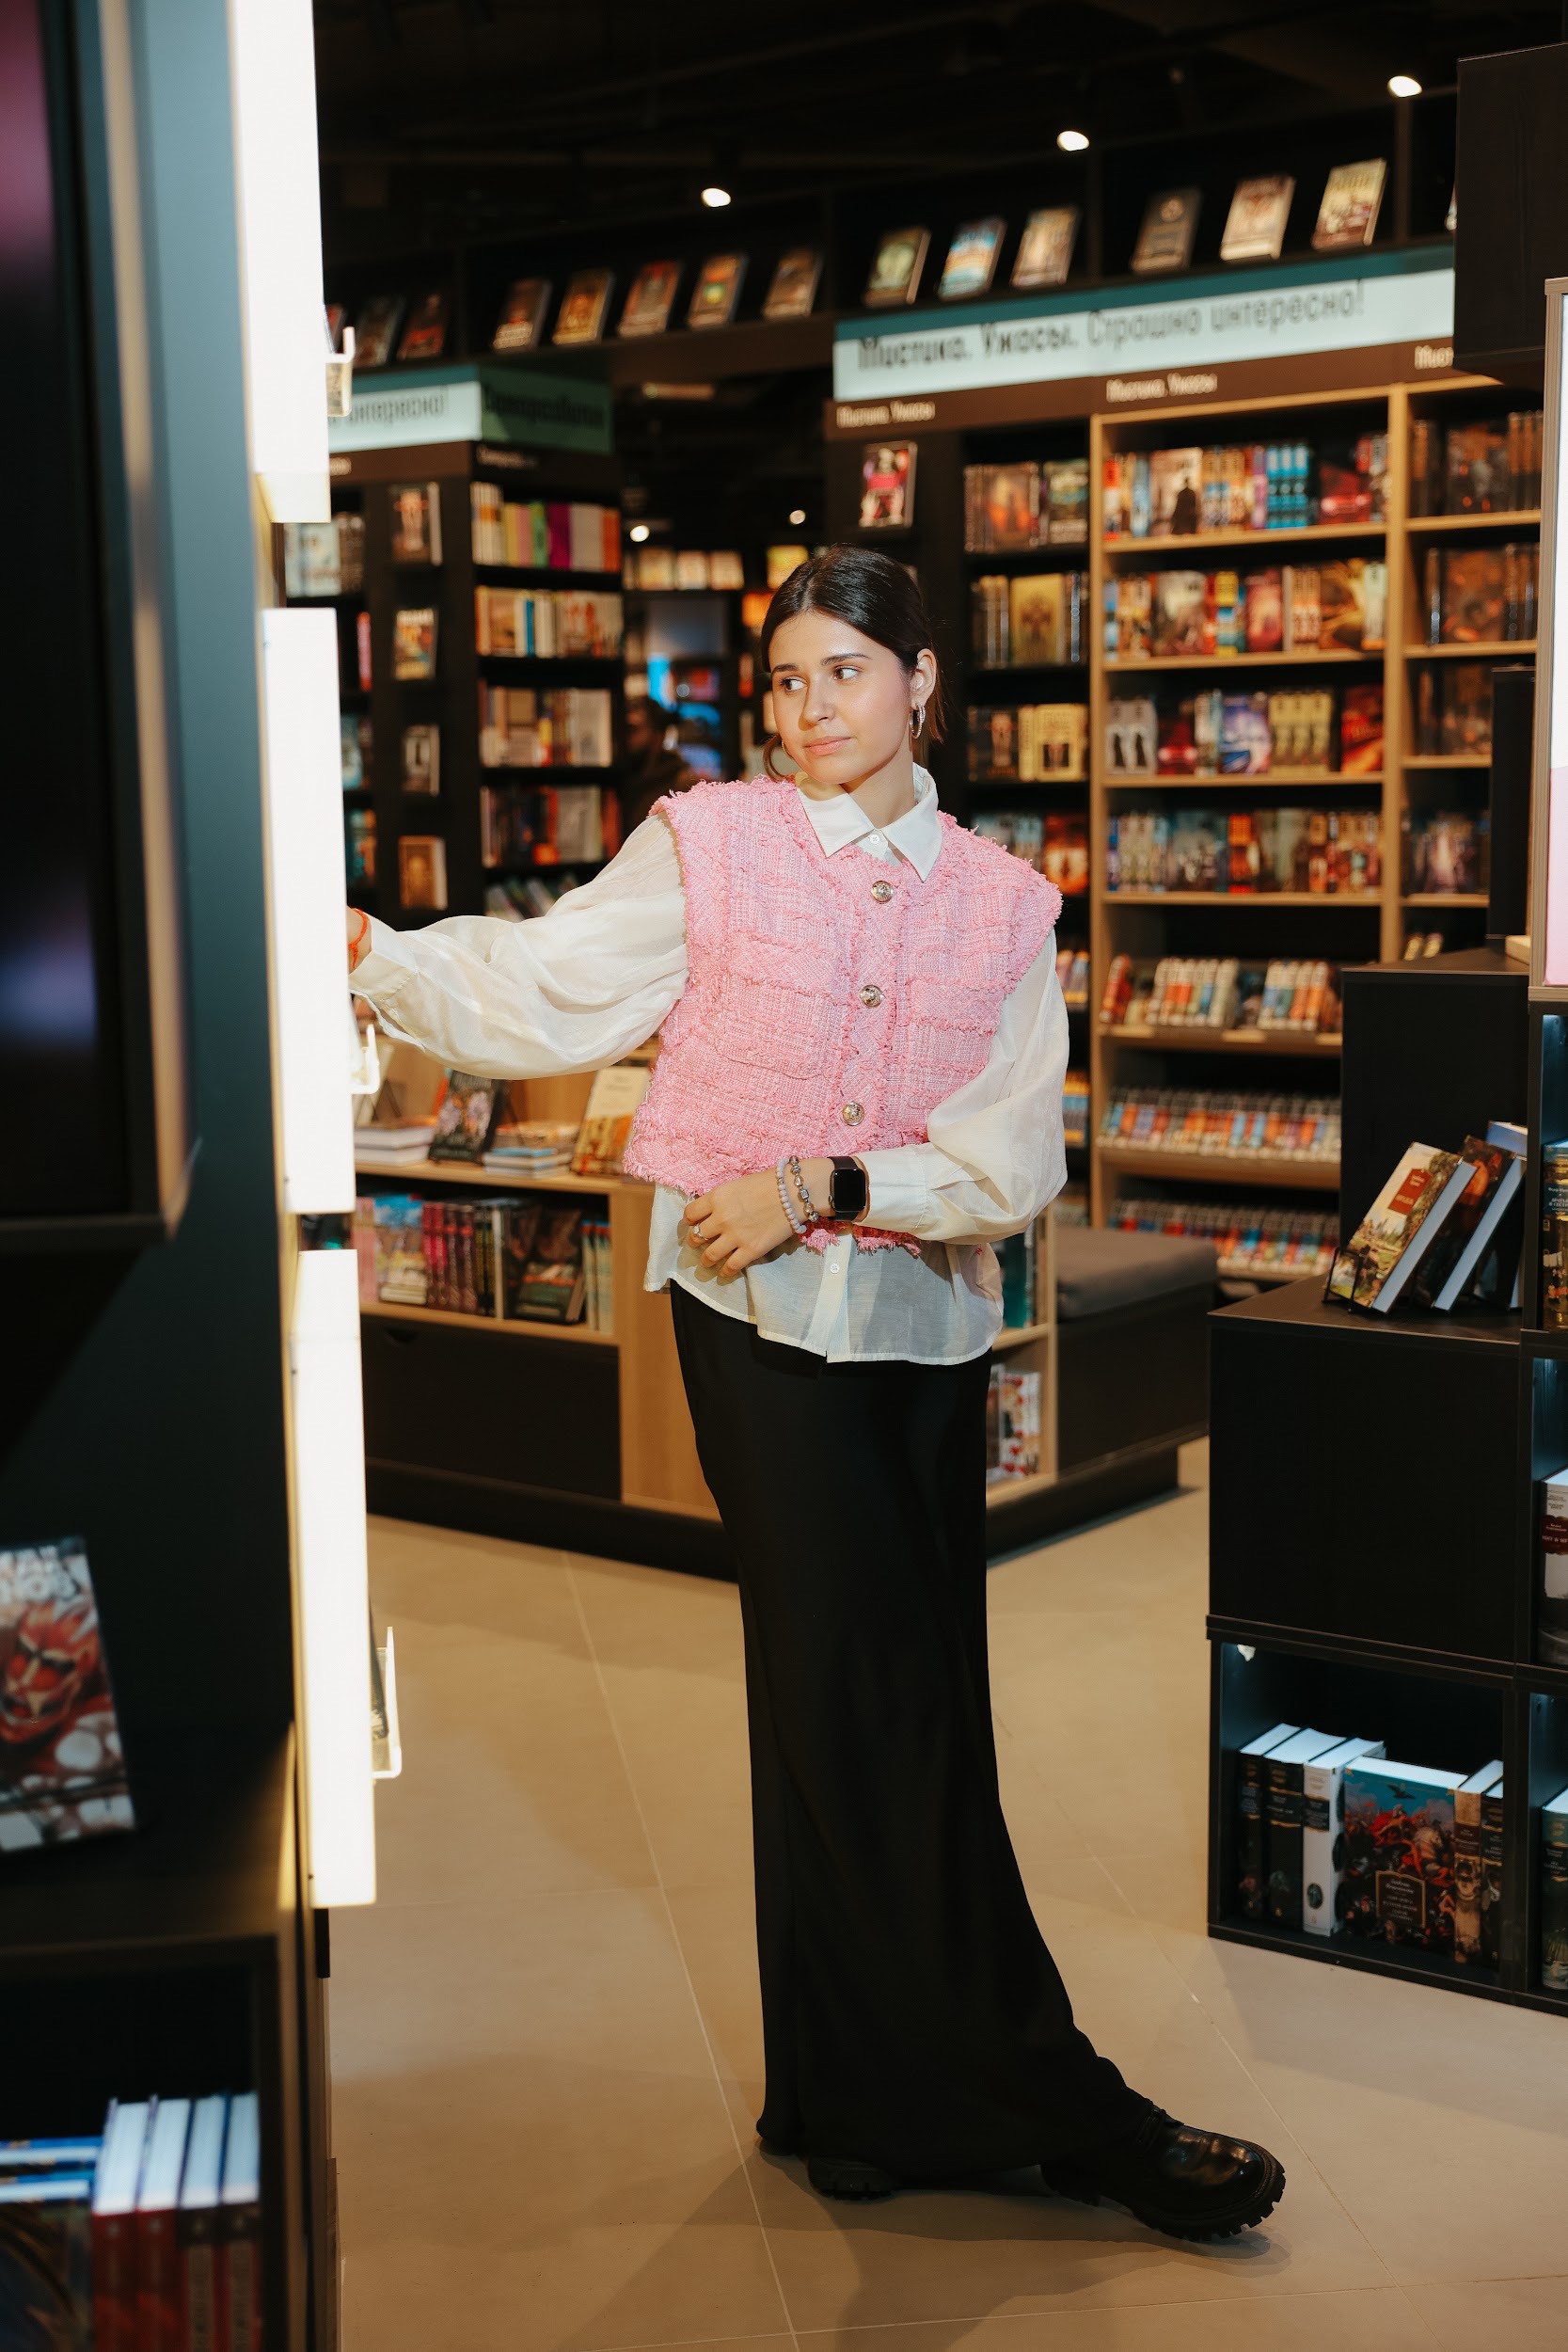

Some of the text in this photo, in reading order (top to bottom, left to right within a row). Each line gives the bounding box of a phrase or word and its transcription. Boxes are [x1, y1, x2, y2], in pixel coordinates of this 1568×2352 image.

[858, 278, 1365, 370] Мистика. Ужасы. Страшно интересно!
